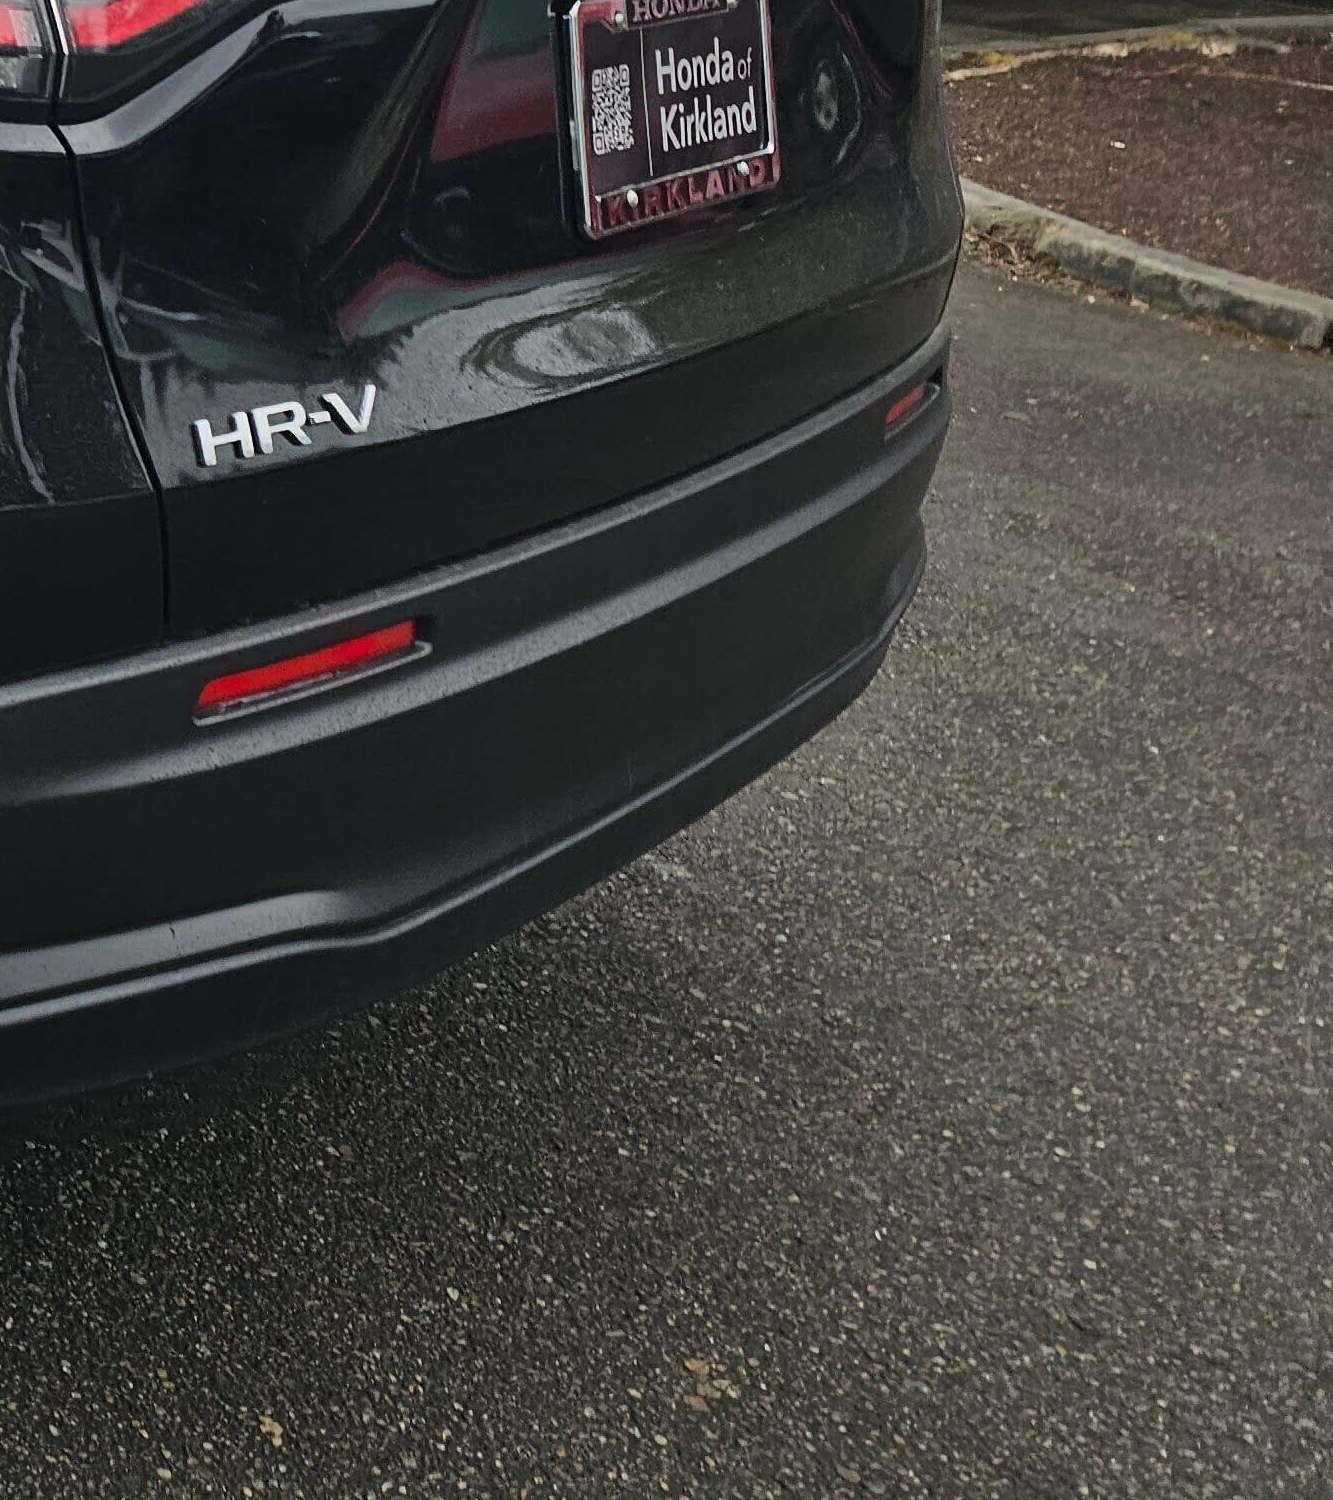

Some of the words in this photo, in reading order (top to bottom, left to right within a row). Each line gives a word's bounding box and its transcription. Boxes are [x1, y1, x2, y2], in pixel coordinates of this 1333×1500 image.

[655, 37, 734, 95] Honda
[737, 47, 753, 80] of
[660, 86, 757, 152] Kirkland
[193, 384, 376, 466] HR-V
